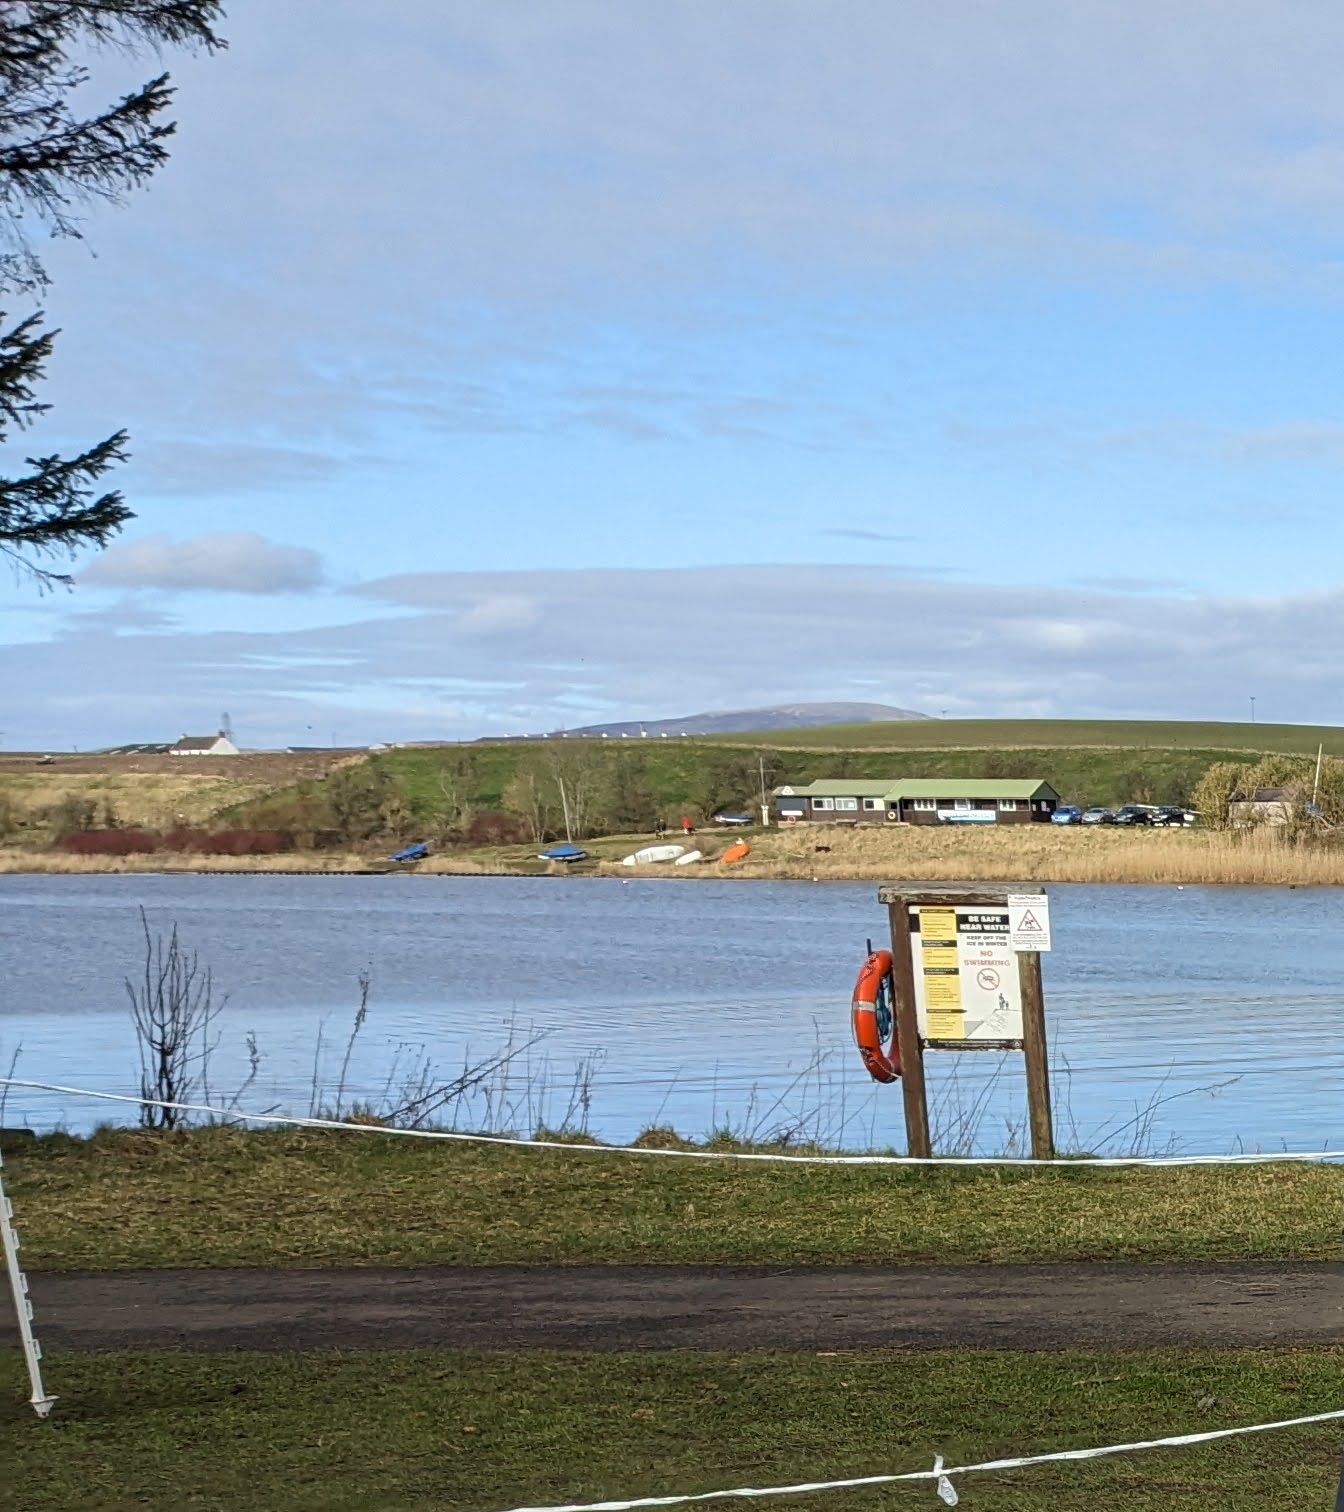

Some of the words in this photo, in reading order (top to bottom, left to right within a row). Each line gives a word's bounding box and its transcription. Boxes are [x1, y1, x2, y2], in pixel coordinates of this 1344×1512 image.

[967, 915, 980, 923] BE
[980, 915, 1001, 923] SAFE
[960, 923, 982, 931] NEAR
[980, 950, 993, 958] NO
[963, 959, 1011, 967] SWIMMING
